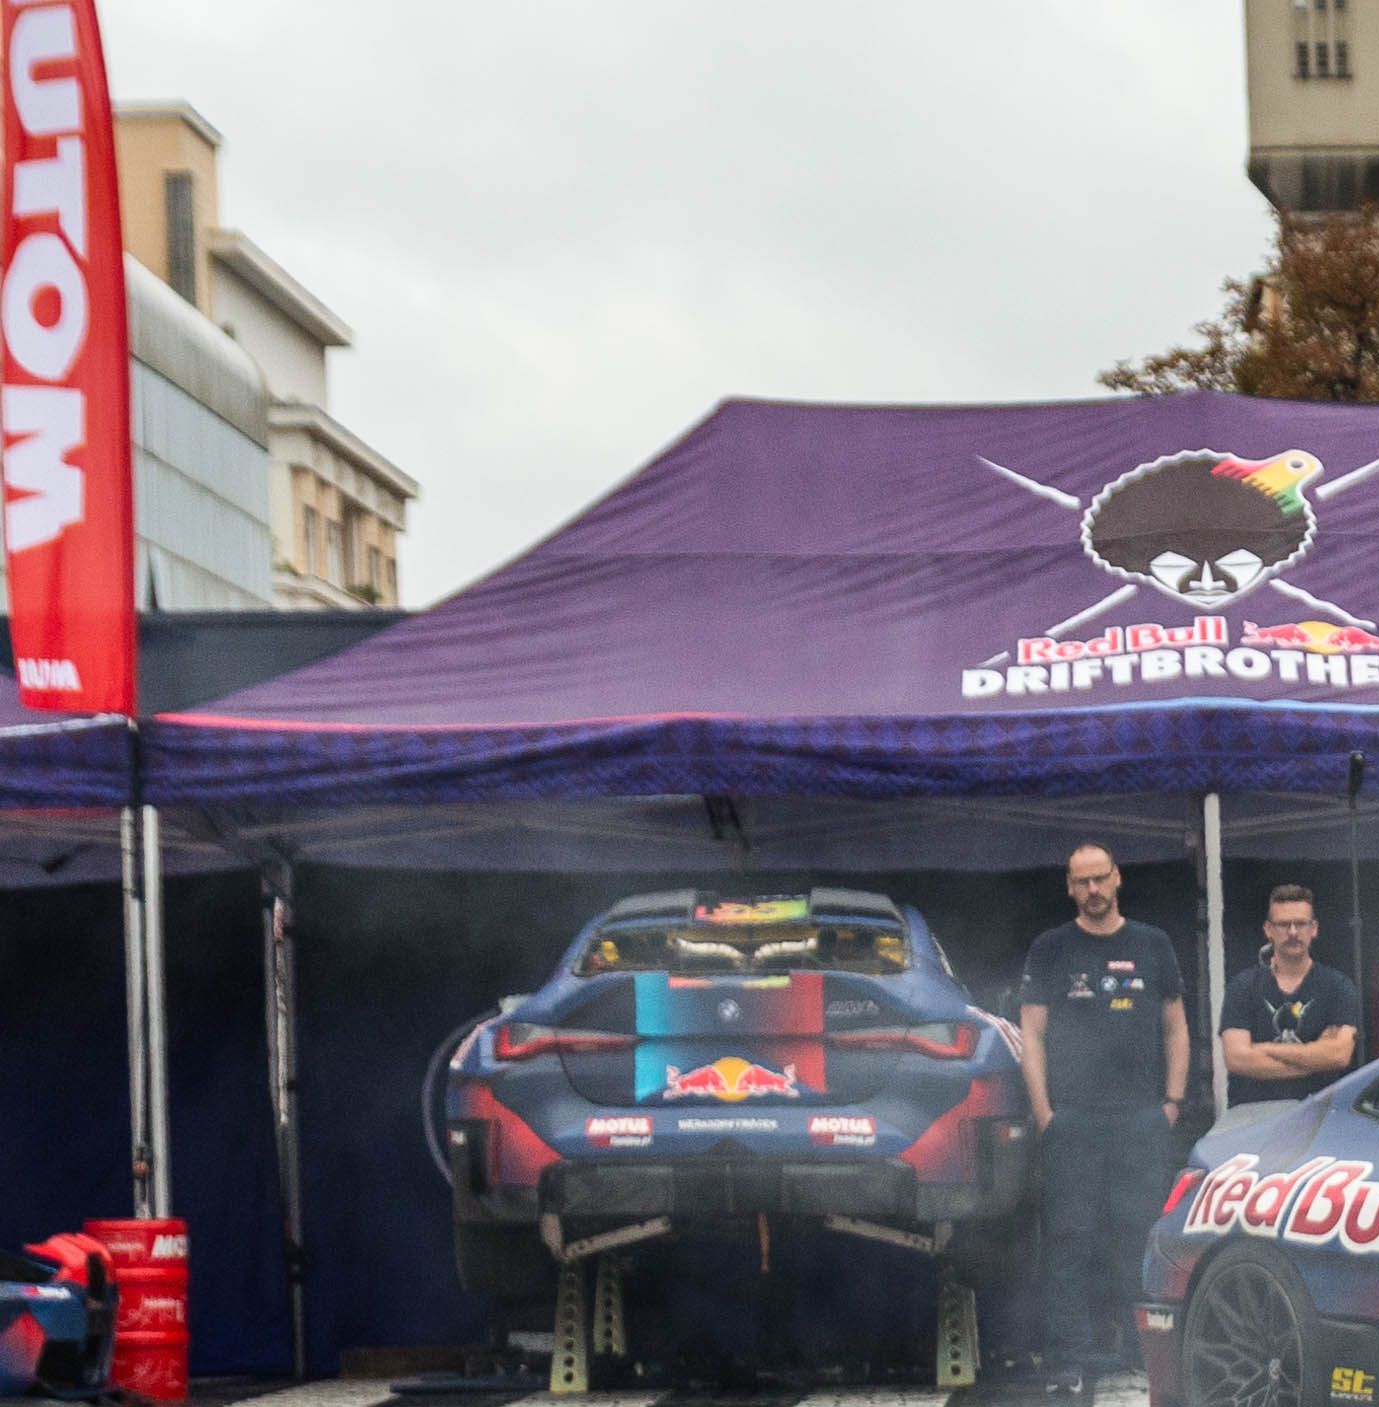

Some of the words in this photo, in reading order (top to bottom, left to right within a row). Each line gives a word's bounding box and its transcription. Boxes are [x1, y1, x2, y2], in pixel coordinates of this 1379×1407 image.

[1018, 627, 1122, 665] Red
[1126, 616, 1227, 653] Bull
[587, 1116, 651, 1135] MOTUL
[810, 1116, 873, 1134] MOTUL
[1183, 1153, 1336, 1237] Red
